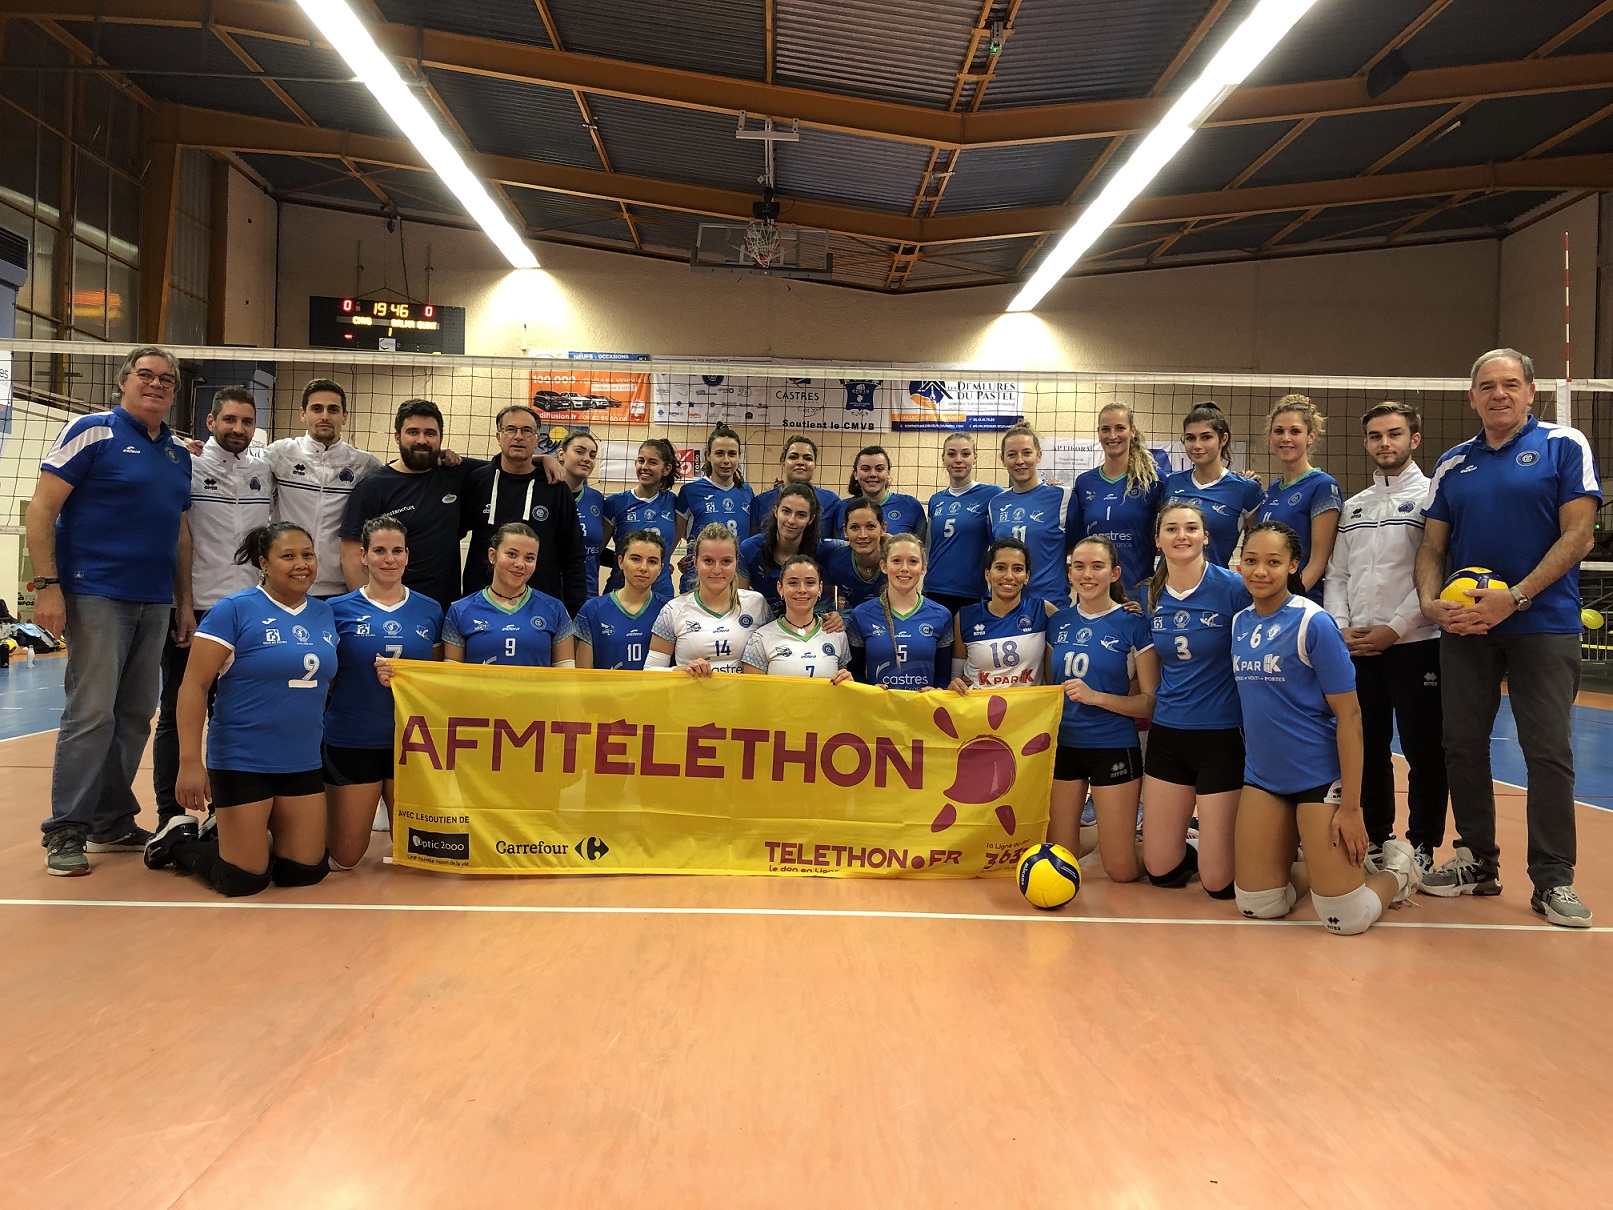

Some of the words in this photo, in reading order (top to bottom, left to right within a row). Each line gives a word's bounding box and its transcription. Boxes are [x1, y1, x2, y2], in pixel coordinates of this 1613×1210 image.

[342, 300, 352, 311] 0
[424, 306, 433, 317] 0
[957, 381, 1016, 391] DEMEURES
[776, 390, 820, 401] CASTRES
[957, 391, 973, 400] DU
[976, 391, 1016, 400] PASTEL
[782, 420, 827, 429] Soutient
[830, 422, 840, 430] le
[844, 422, 874, 430] CMVB
[1106, 506, 1111, 520] 1
[944, 518, 956, 538] 5
[1250, 624, 1262, 648] 6
[386, 644, 402, 658] 7
[505, 638, 516, 656] 9
[627, 644, 642, 662] 10
[714, 640, 732, 656] 14
[896, 644, 908, 662] 5
[990, 640, 1020, 668] 18
[1174, 636, 1192, 660] 3
[304, 652, 320, 680] 9
[1064, 651, 1090, 678] 10
[806, 666, 815, 678] 7
[882, 674, 928, 685] castres
[398, 810, 414, 819] AVEC
[440, 840, 464, 850] 2000
[496, 840, 568, 855] Carrefour
